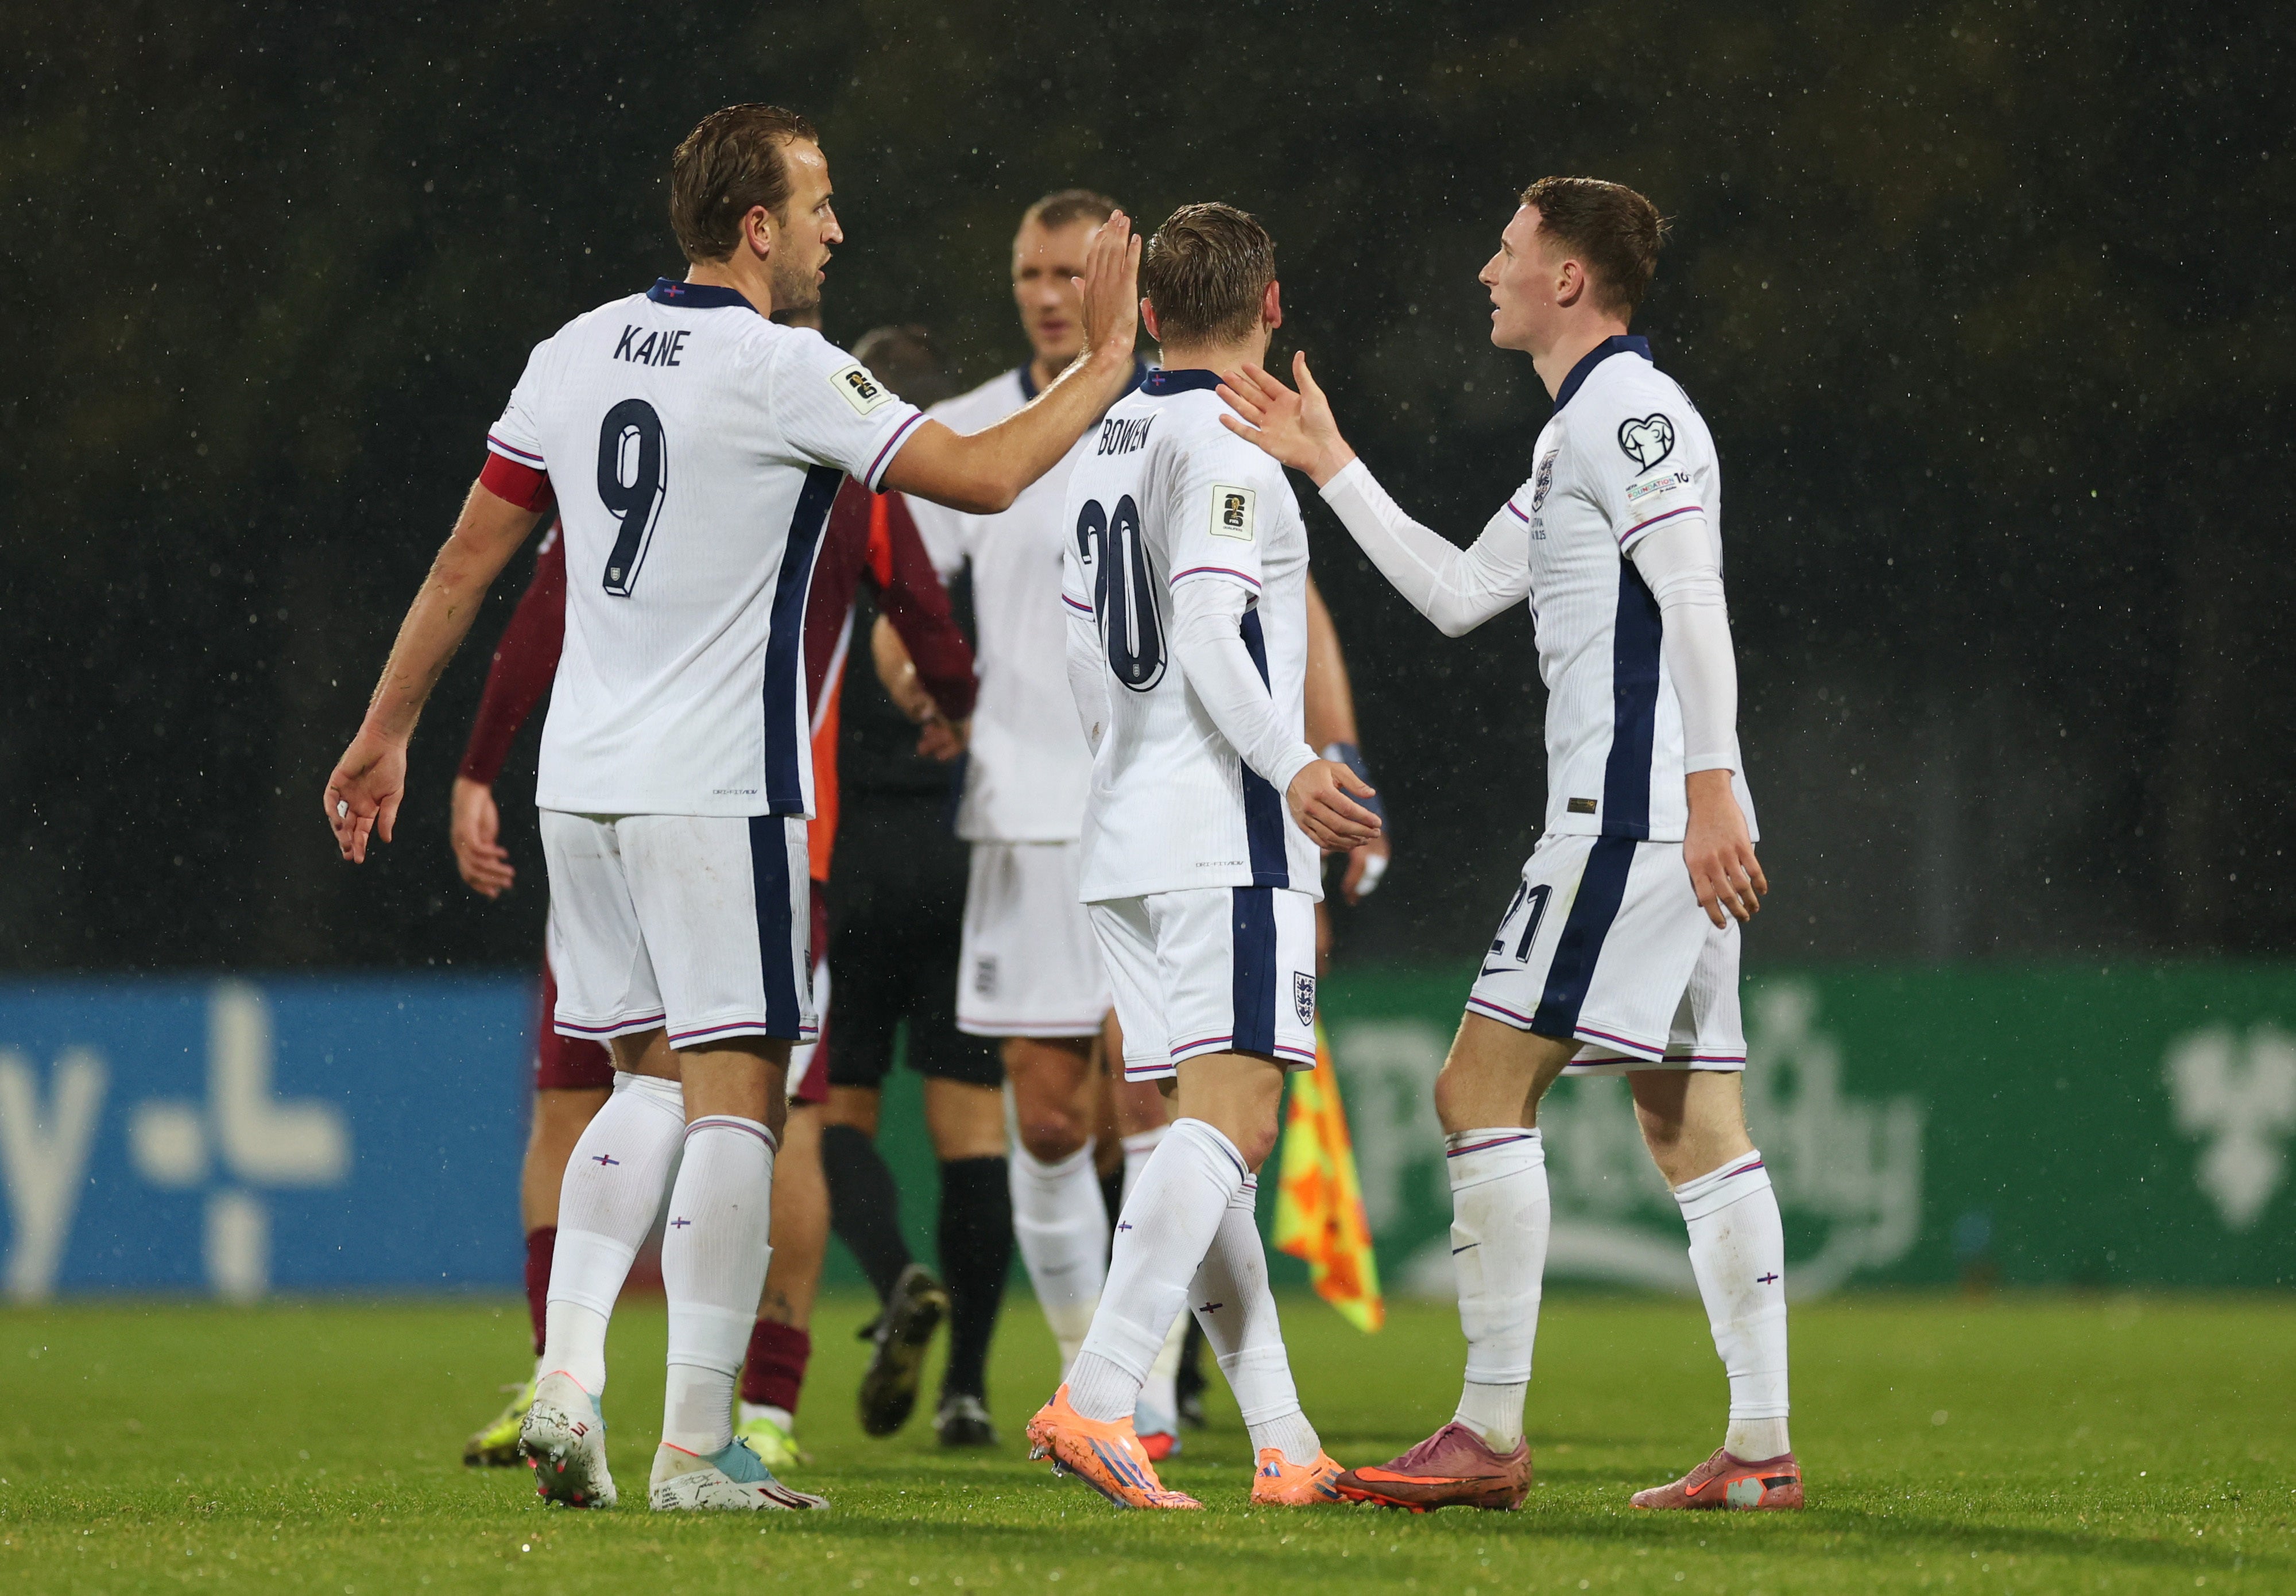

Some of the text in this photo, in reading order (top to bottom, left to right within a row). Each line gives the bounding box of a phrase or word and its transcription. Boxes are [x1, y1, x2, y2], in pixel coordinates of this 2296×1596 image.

[613, 324, 691, 366] KANE
[1097, 413, 1157, 456] BOWEN
[597, 398, 667, 598] 9
[1628, 478, 1674, 498] FOUNDATION
[1077, 494, 1168, 692] 20
